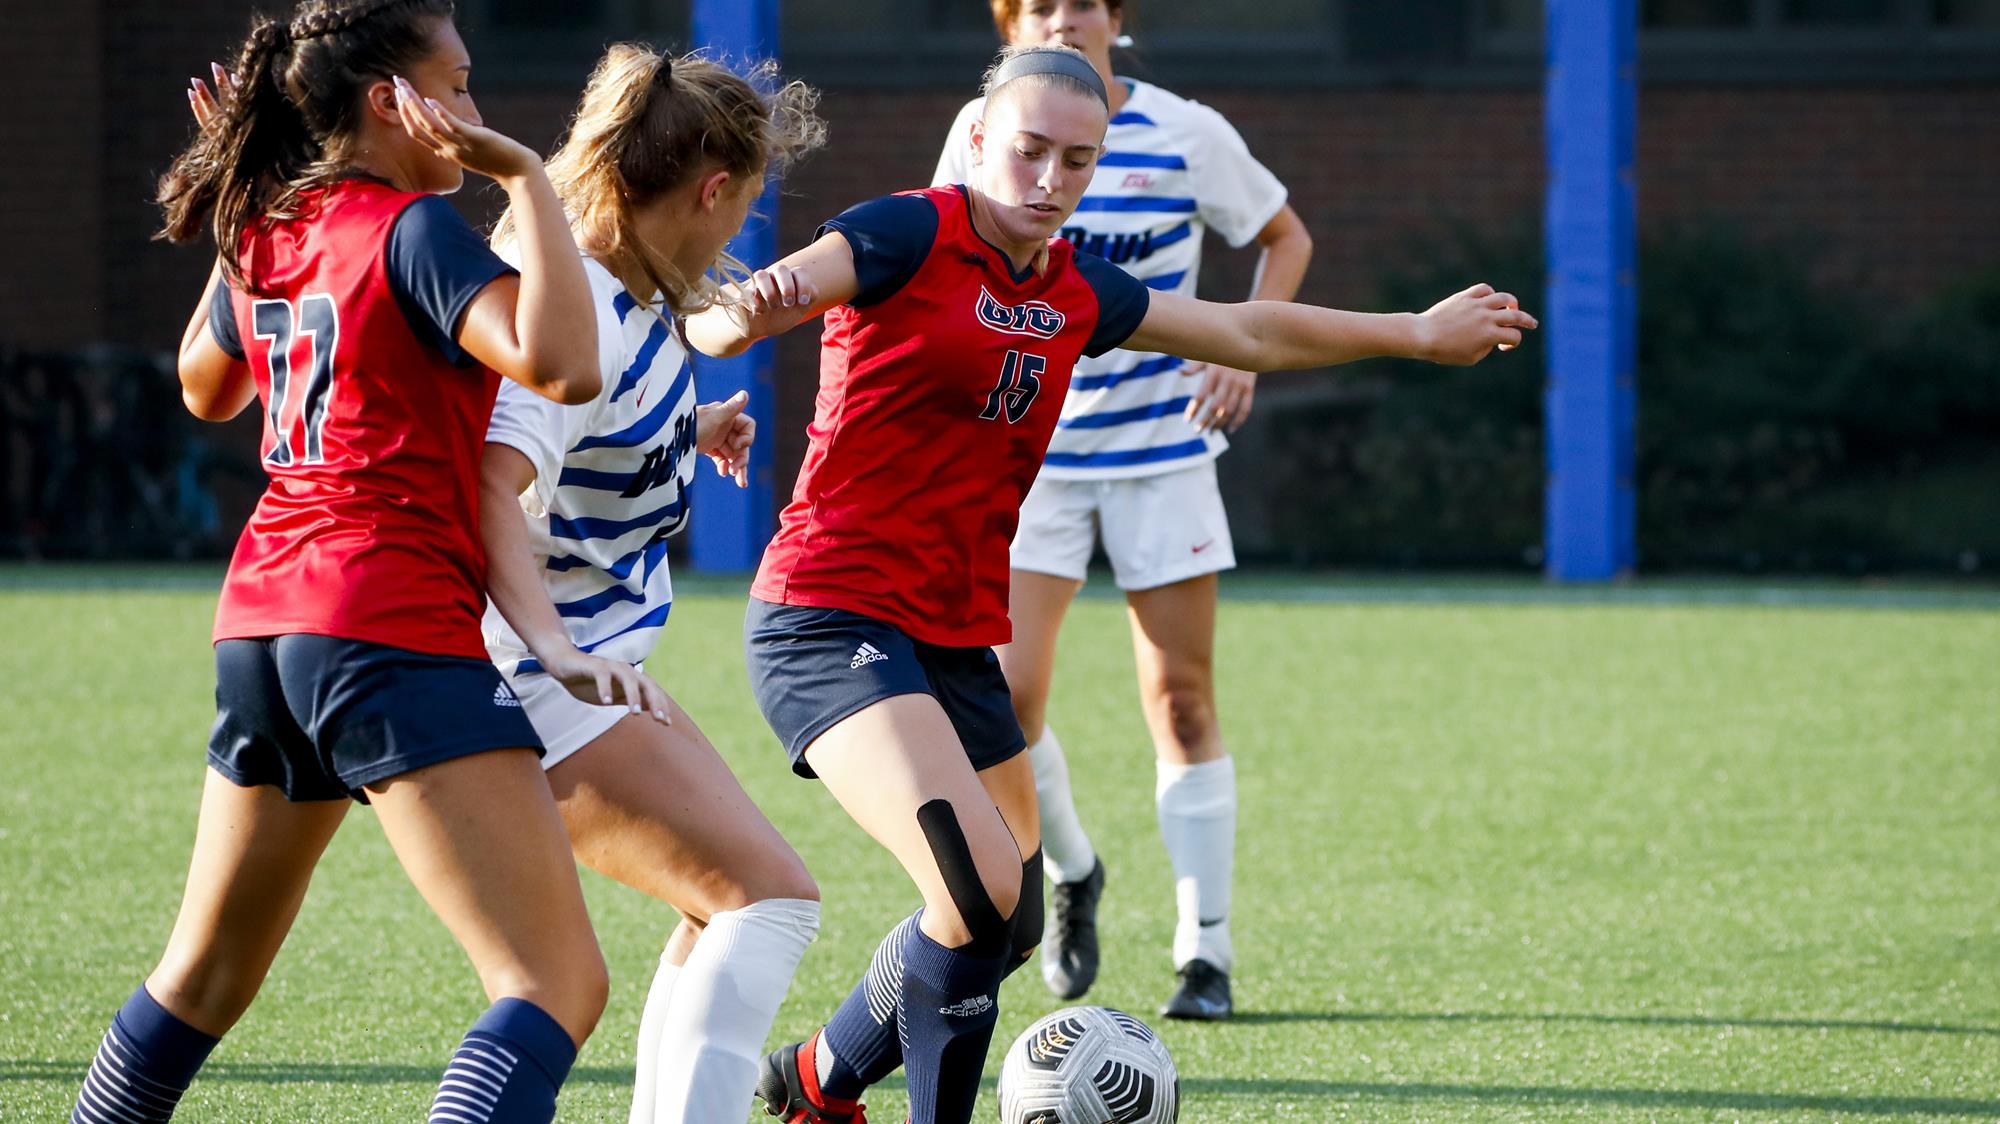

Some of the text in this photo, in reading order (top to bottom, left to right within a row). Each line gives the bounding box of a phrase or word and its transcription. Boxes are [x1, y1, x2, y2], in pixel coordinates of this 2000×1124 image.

[978, 288, 1065, 337] UIC
[979, 349, 1046, 424] 15
[850, 653, 889, 669] adidas
[938, 999, 993, 1017] adidas
